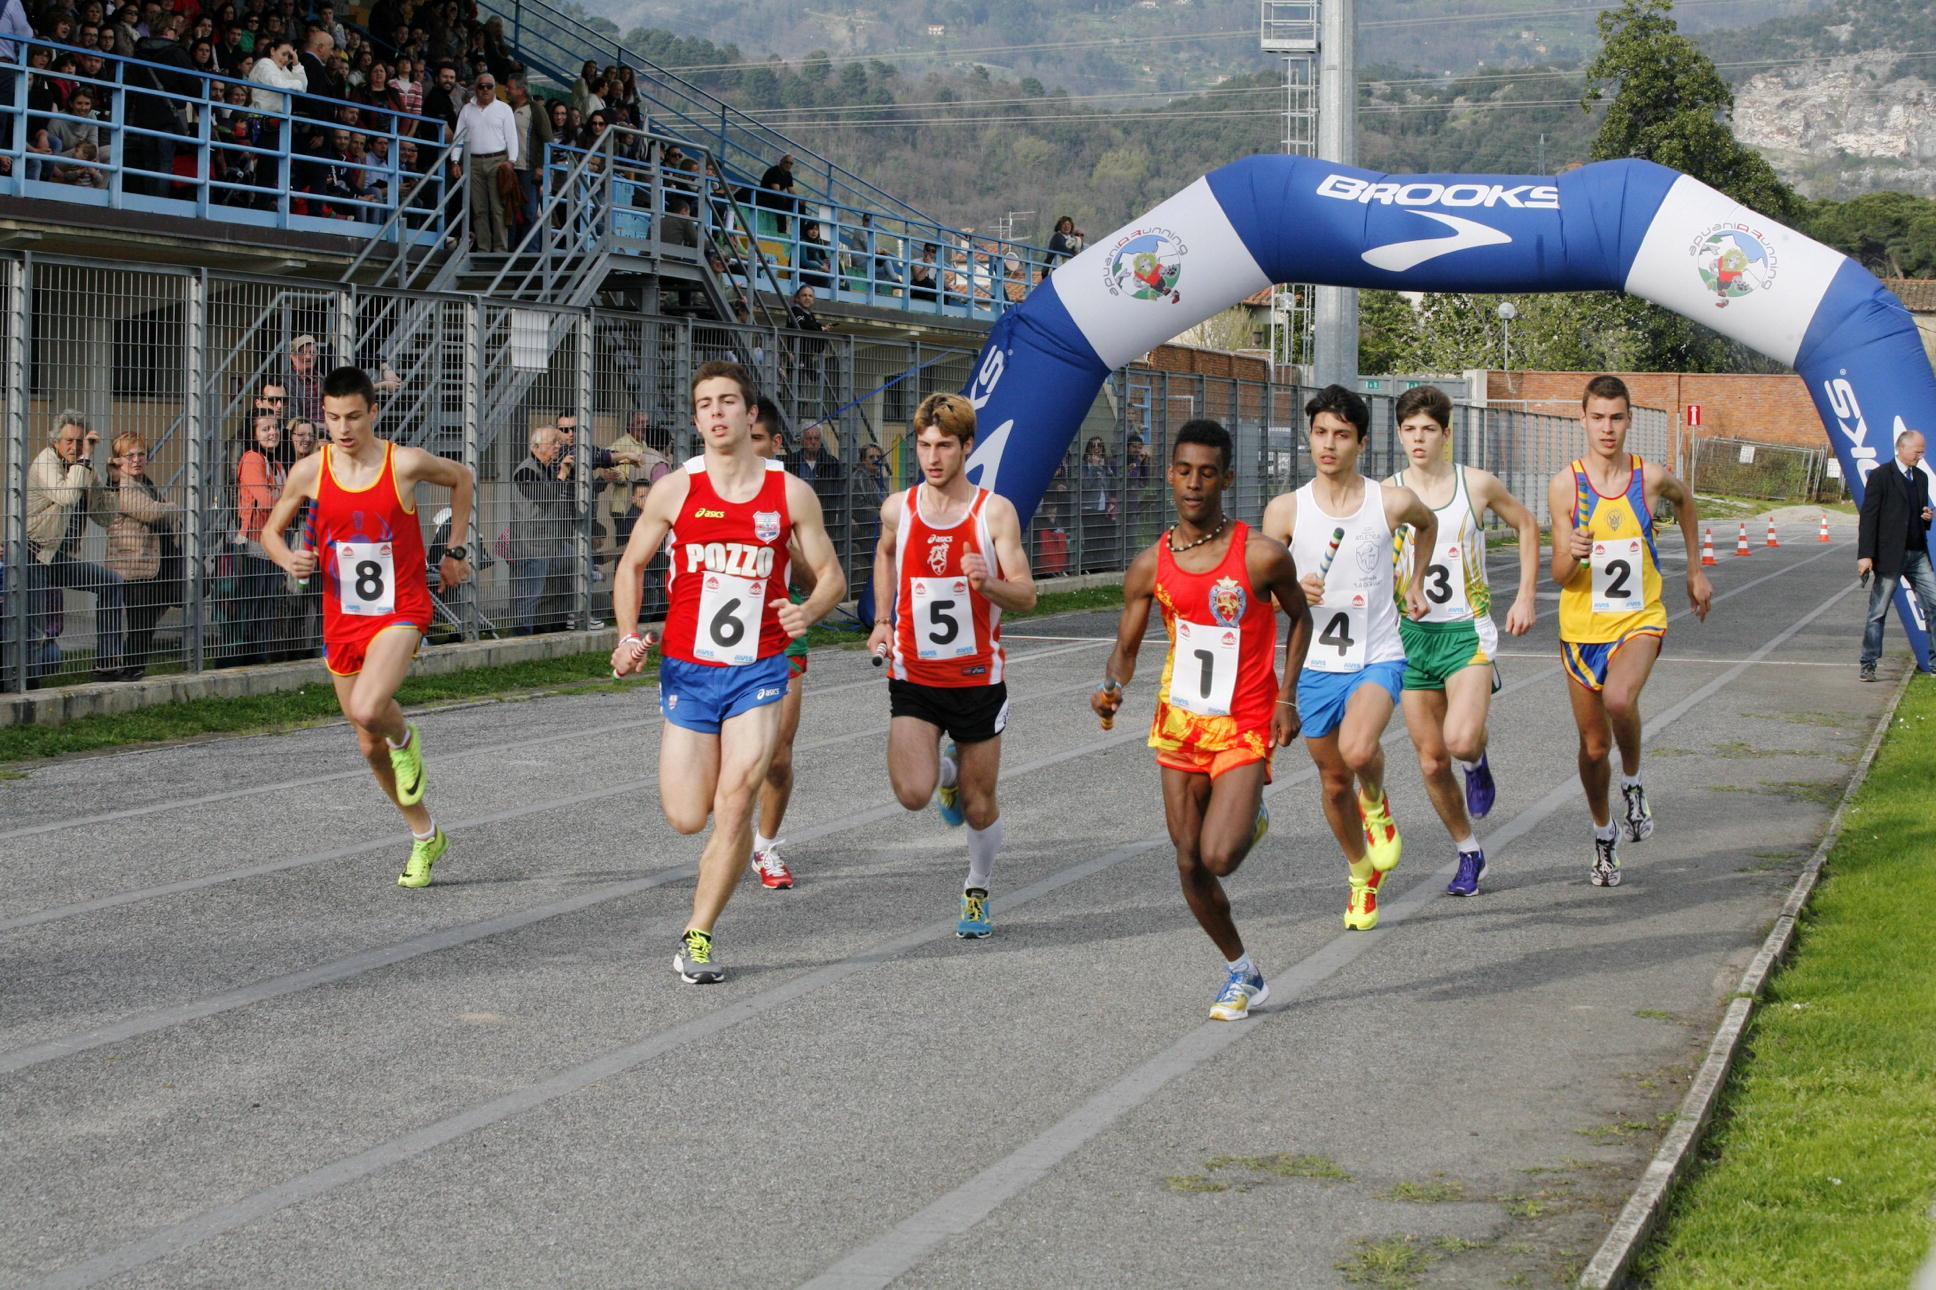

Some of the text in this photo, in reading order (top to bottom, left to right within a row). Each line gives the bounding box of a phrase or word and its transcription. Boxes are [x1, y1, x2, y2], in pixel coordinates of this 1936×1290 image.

[1316, 174, 1560, 209] BROOKS
[355, 560, 385, 602] 8
[686, 543, 775, 578] POZZO
[1604, 559, 1631, 598] 2
[1425, 564, 1453, 604] 3
[710, 597, 744, 647] 6
[929, 600, 958, 645] 5
[1318, 612, 1355, 657] 4
[1194, 649, 1214, 699] 1
